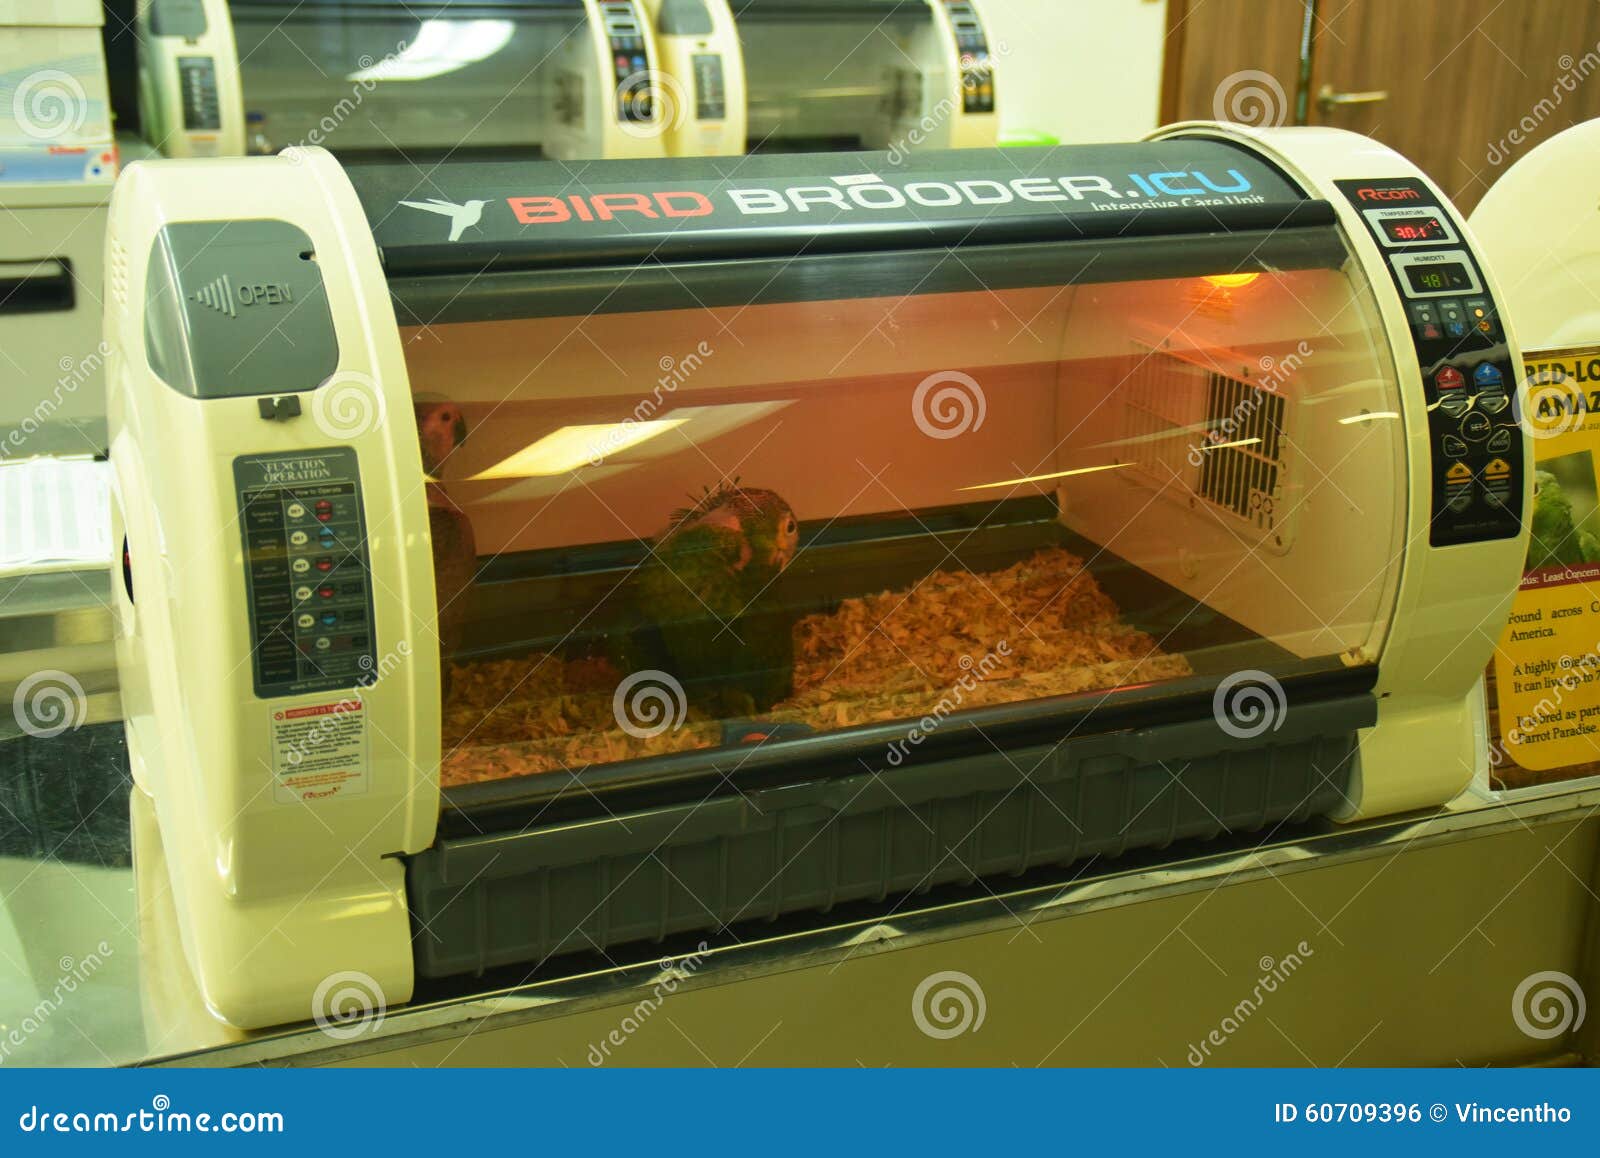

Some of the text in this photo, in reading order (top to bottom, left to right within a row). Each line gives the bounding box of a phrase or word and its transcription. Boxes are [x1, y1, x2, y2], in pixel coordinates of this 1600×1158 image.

[1357, 188, 1420, 200] Rcom
[507, 191, 714, 224] BIRD
[1414, 254, 1446, 262] HUMIDITY
[1421, 274, 1441, 288] 48
[239, 283, 292, 306] OPEN
[267, 459, 326, 471] FUNCTION
[264, 469, 330, 482] OPERATION
[1543, 572, 1565, 583] Least
[1565, 568, 1599, 580] Concern
[1552, 606, 1583, 618] across
[1510, 627, 1557, 641] America.
[1513, 665, 1522, 676] A
[1525, 659, 1558, 676] highly
[1514, 682, 1522, 693] It
[1524, 681, 1542, 692] can
[1545, 677, 1563, 688] live
[1539, 709, 1563, 723] bred
[1566, 710, 1577, 719] as
[1519, 730, 1551, 744] Parrot
